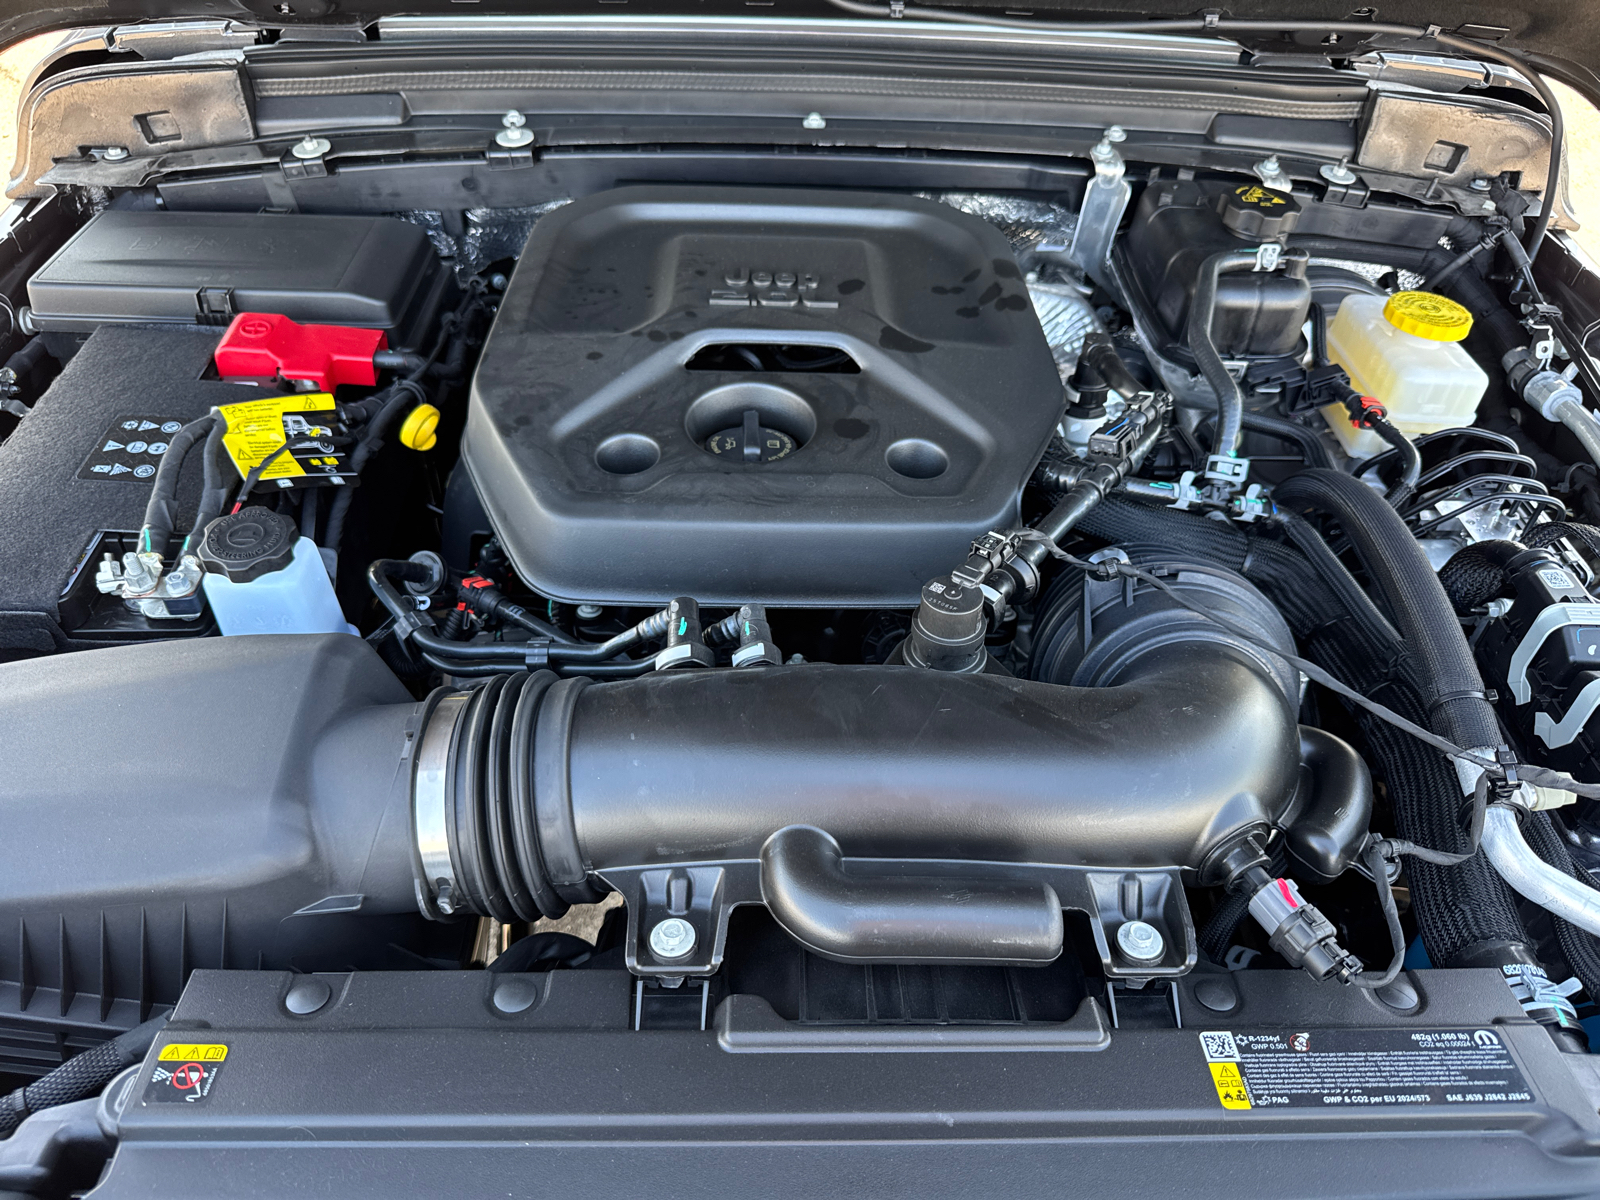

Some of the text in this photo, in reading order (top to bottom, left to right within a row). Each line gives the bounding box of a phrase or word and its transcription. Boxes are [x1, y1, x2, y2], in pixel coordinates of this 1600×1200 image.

[725, 268, 819, 292] Jeep
[239, 510, 279, 526] APPROVED
[222, 547, 264, 559] STEERING
[1248, 1035, 1281, 1043] R-1234yf
[1411, 1033, 1432, 1042] 482g
[1272, 1096, 1290, 1104] PAG
[1351, 1095, 1369, 1103] CO2
[1370, 1096, 1384, 1104] per
[1397, 1094, 1431, 1102] 2024/573
[1446, 1094, 1464, 1102] SAE
